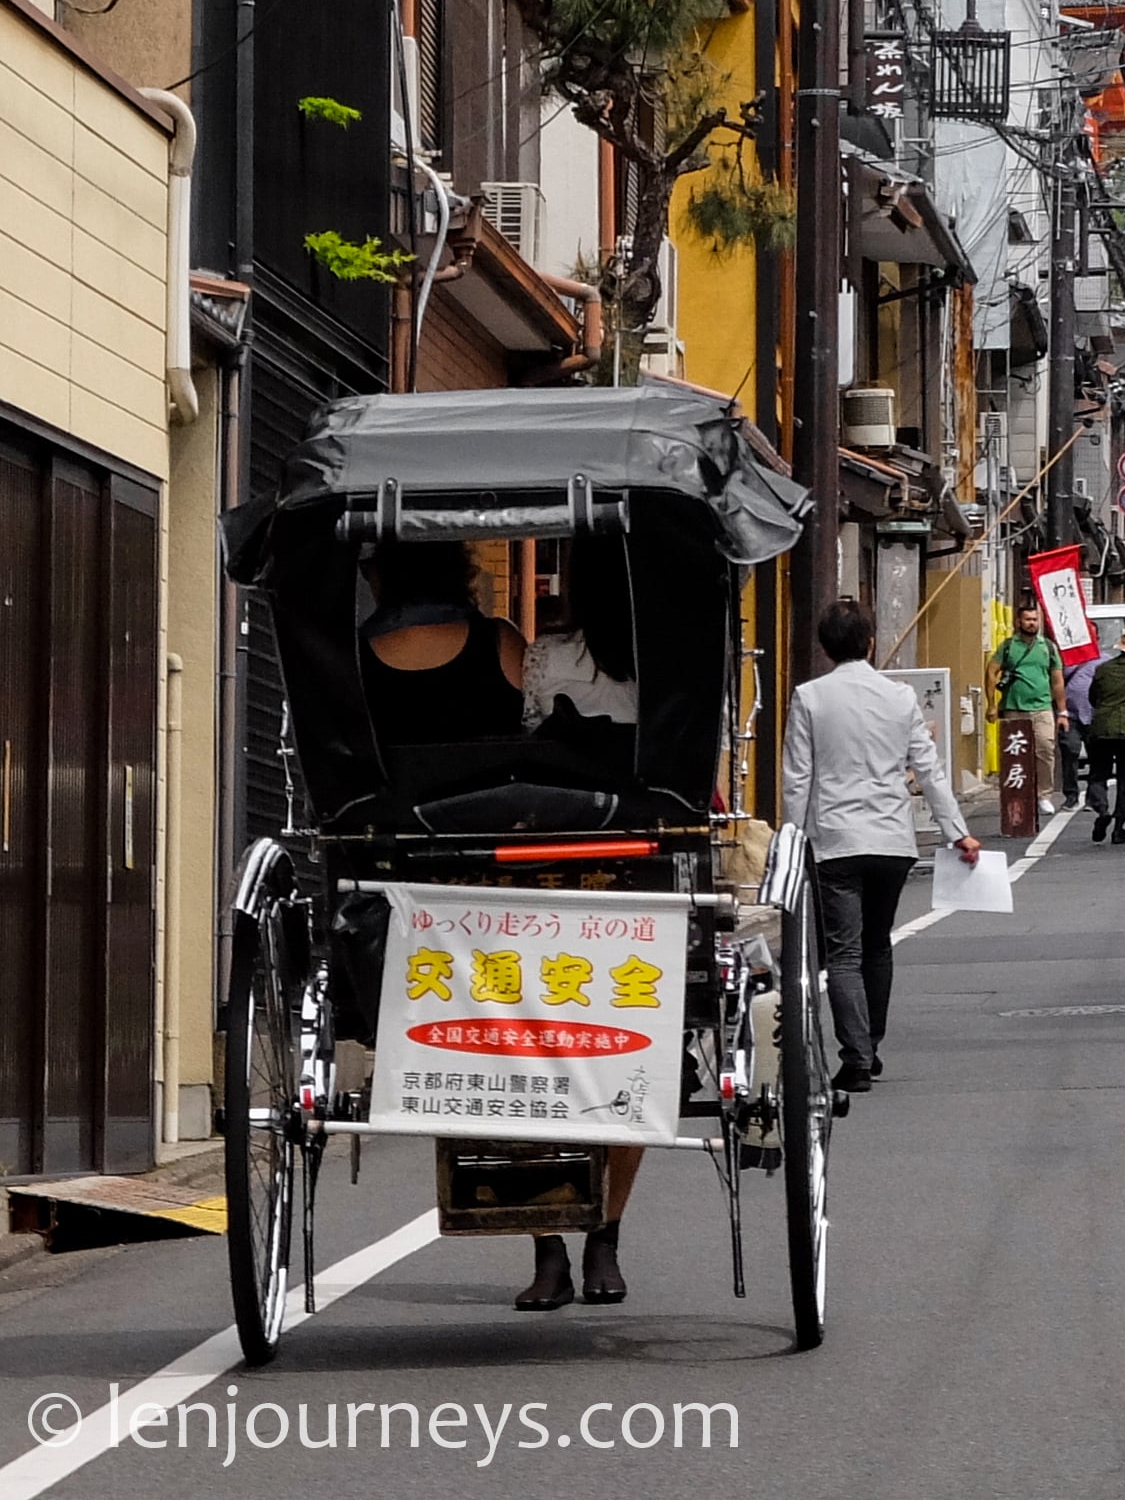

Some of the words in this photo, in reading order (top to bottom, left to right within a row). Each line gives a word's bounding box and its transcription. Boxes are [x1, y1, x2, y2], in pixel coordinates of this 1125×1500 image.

[1003, 730, 1028, 789] 茶房
[412, 909, 562, 939] ゆっくり走ろう
[579, 916, 656, 941] 京の道
[406, 947, 663, 1008] 交通安全
[427, 1026, 631, 1050] 全国交通安全運動実施中
[403, 1071, 571, 1096] 京都府東山警察署
[400, 1096, 570, 1120] 東山交通安全協会
